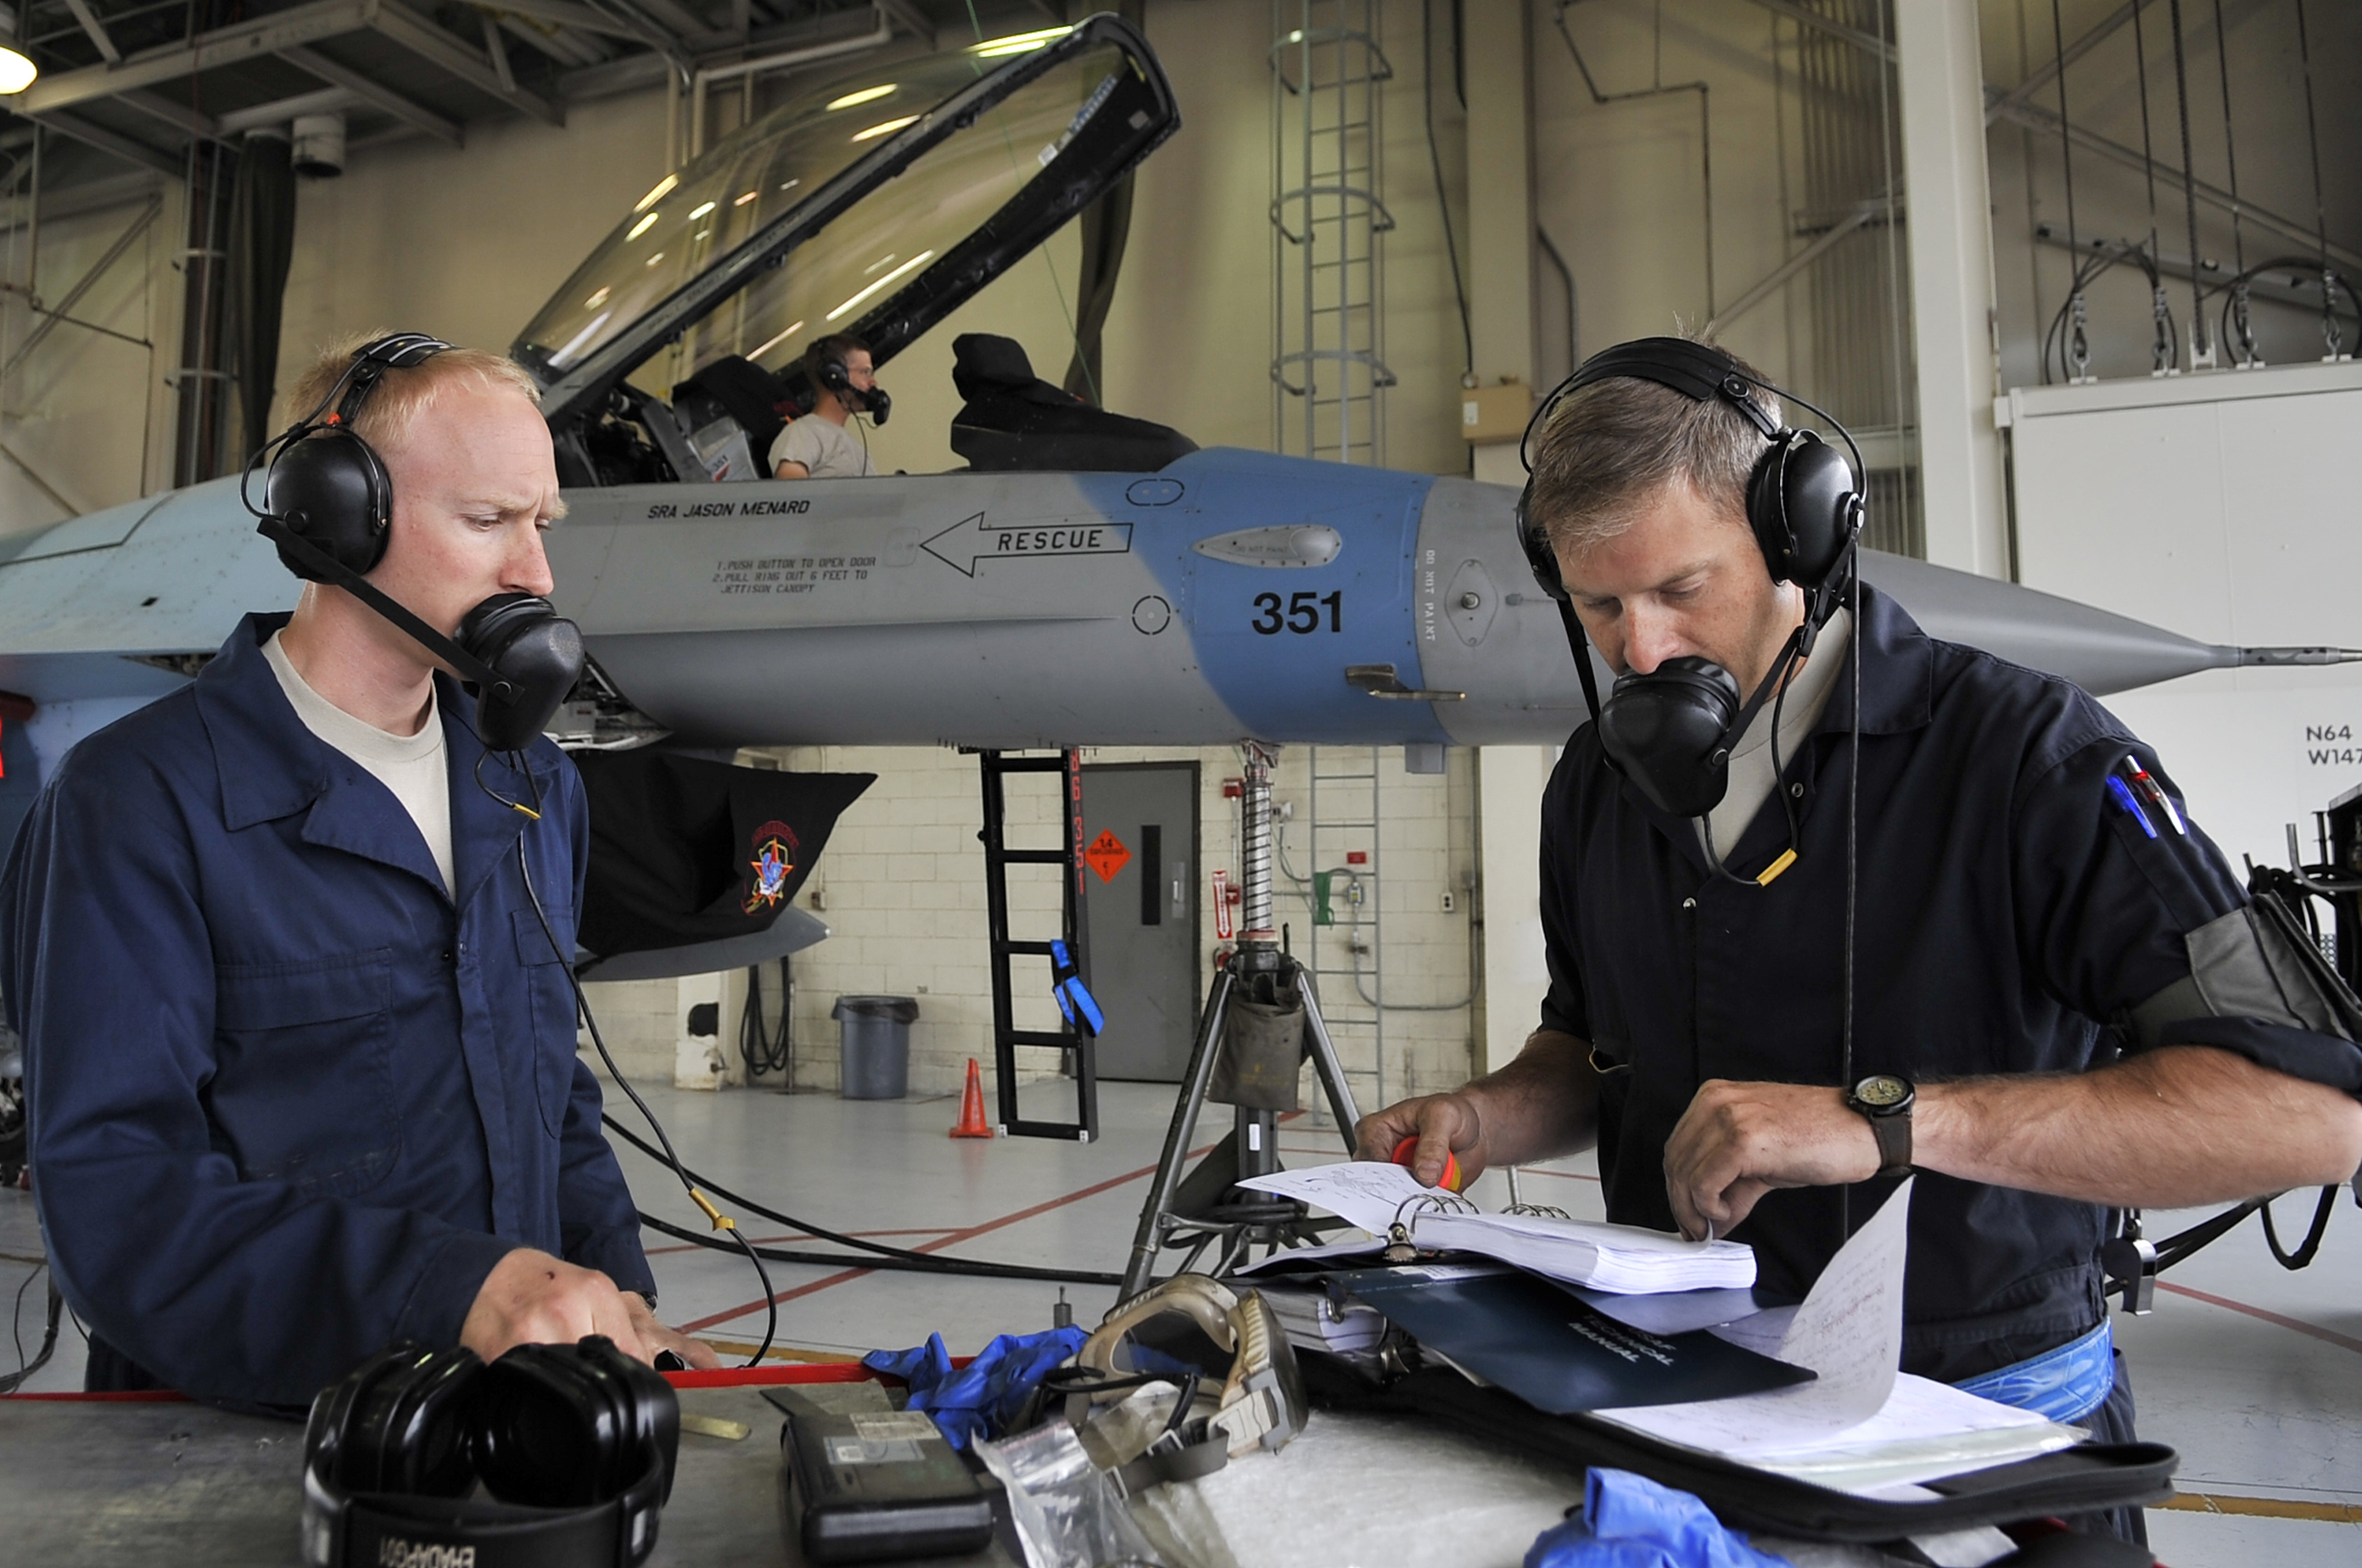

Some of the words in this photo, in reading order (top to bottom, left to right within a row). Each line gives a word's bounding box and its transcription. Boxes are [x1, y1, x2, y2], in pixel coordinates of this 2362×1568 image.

[647, 505, 677, 518] SRA
[683, 503, 736, 518] JASON
[740, 500, 810, 516] MENARD
[998, 529, 1102, 551] RESCUE
[758, 558, 795, 570] BUTTON
[802, 558, 814, 568] TO
[819, 557, 844, 568] OPEN
[850, 557, 876, 567] DOOR
[1426, 550, 1436, 564] DO
[755, 572, 781, 582] RING
[786, 571, 804, 581] OUT
[823, 570, 848, 580] FEET
[855, 569, 868, 580] TO
[1425, 571, 1435, 594] NOT
[721, 584, 771, 594] JETTISON
[776, 584, 815, 593] CANOPY
[1252, 591, 1342, 635] 351
[1424, 602, 1436, 641] PAINT
[2306, 725, 2354, 741] N64
[1568, 1322, 1641, 1363] MANUAL
[1582, 1314, 1675, 1366] TECHNICAL
